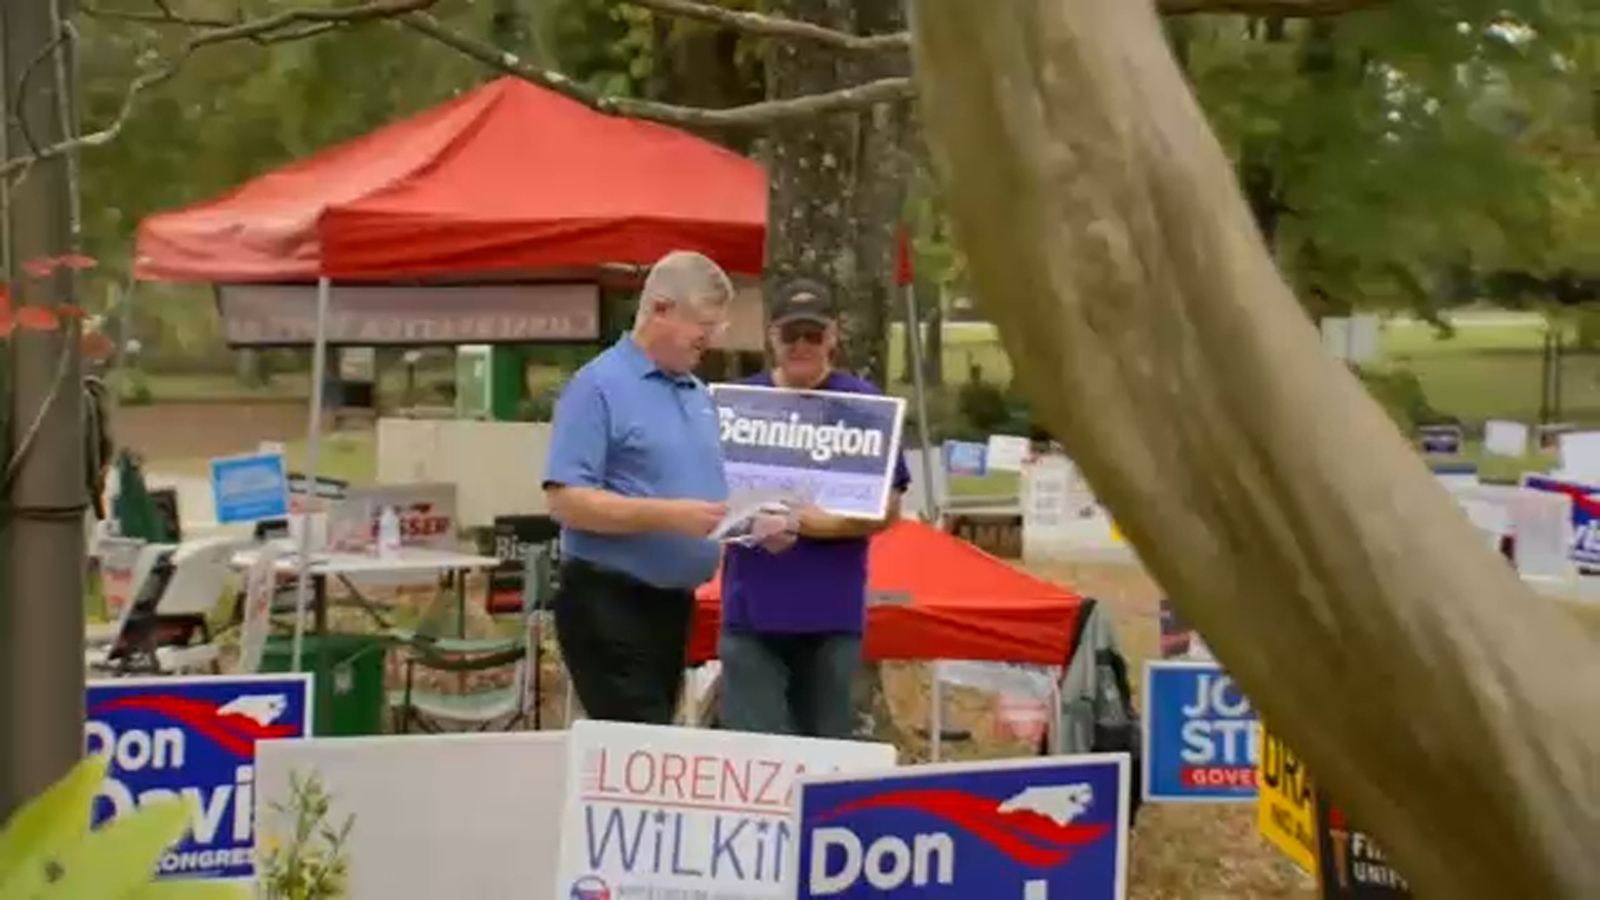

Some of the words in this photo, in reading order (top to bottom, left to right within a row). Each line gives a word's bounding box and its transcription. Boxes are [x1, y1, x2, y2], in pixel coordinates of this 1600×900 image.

[83, 720, 186, 772] Don
[89, 765, 254, 845] Dvi
[154, 847, 256, 873] ONGRE
[809, 826, 954, 897] Don
